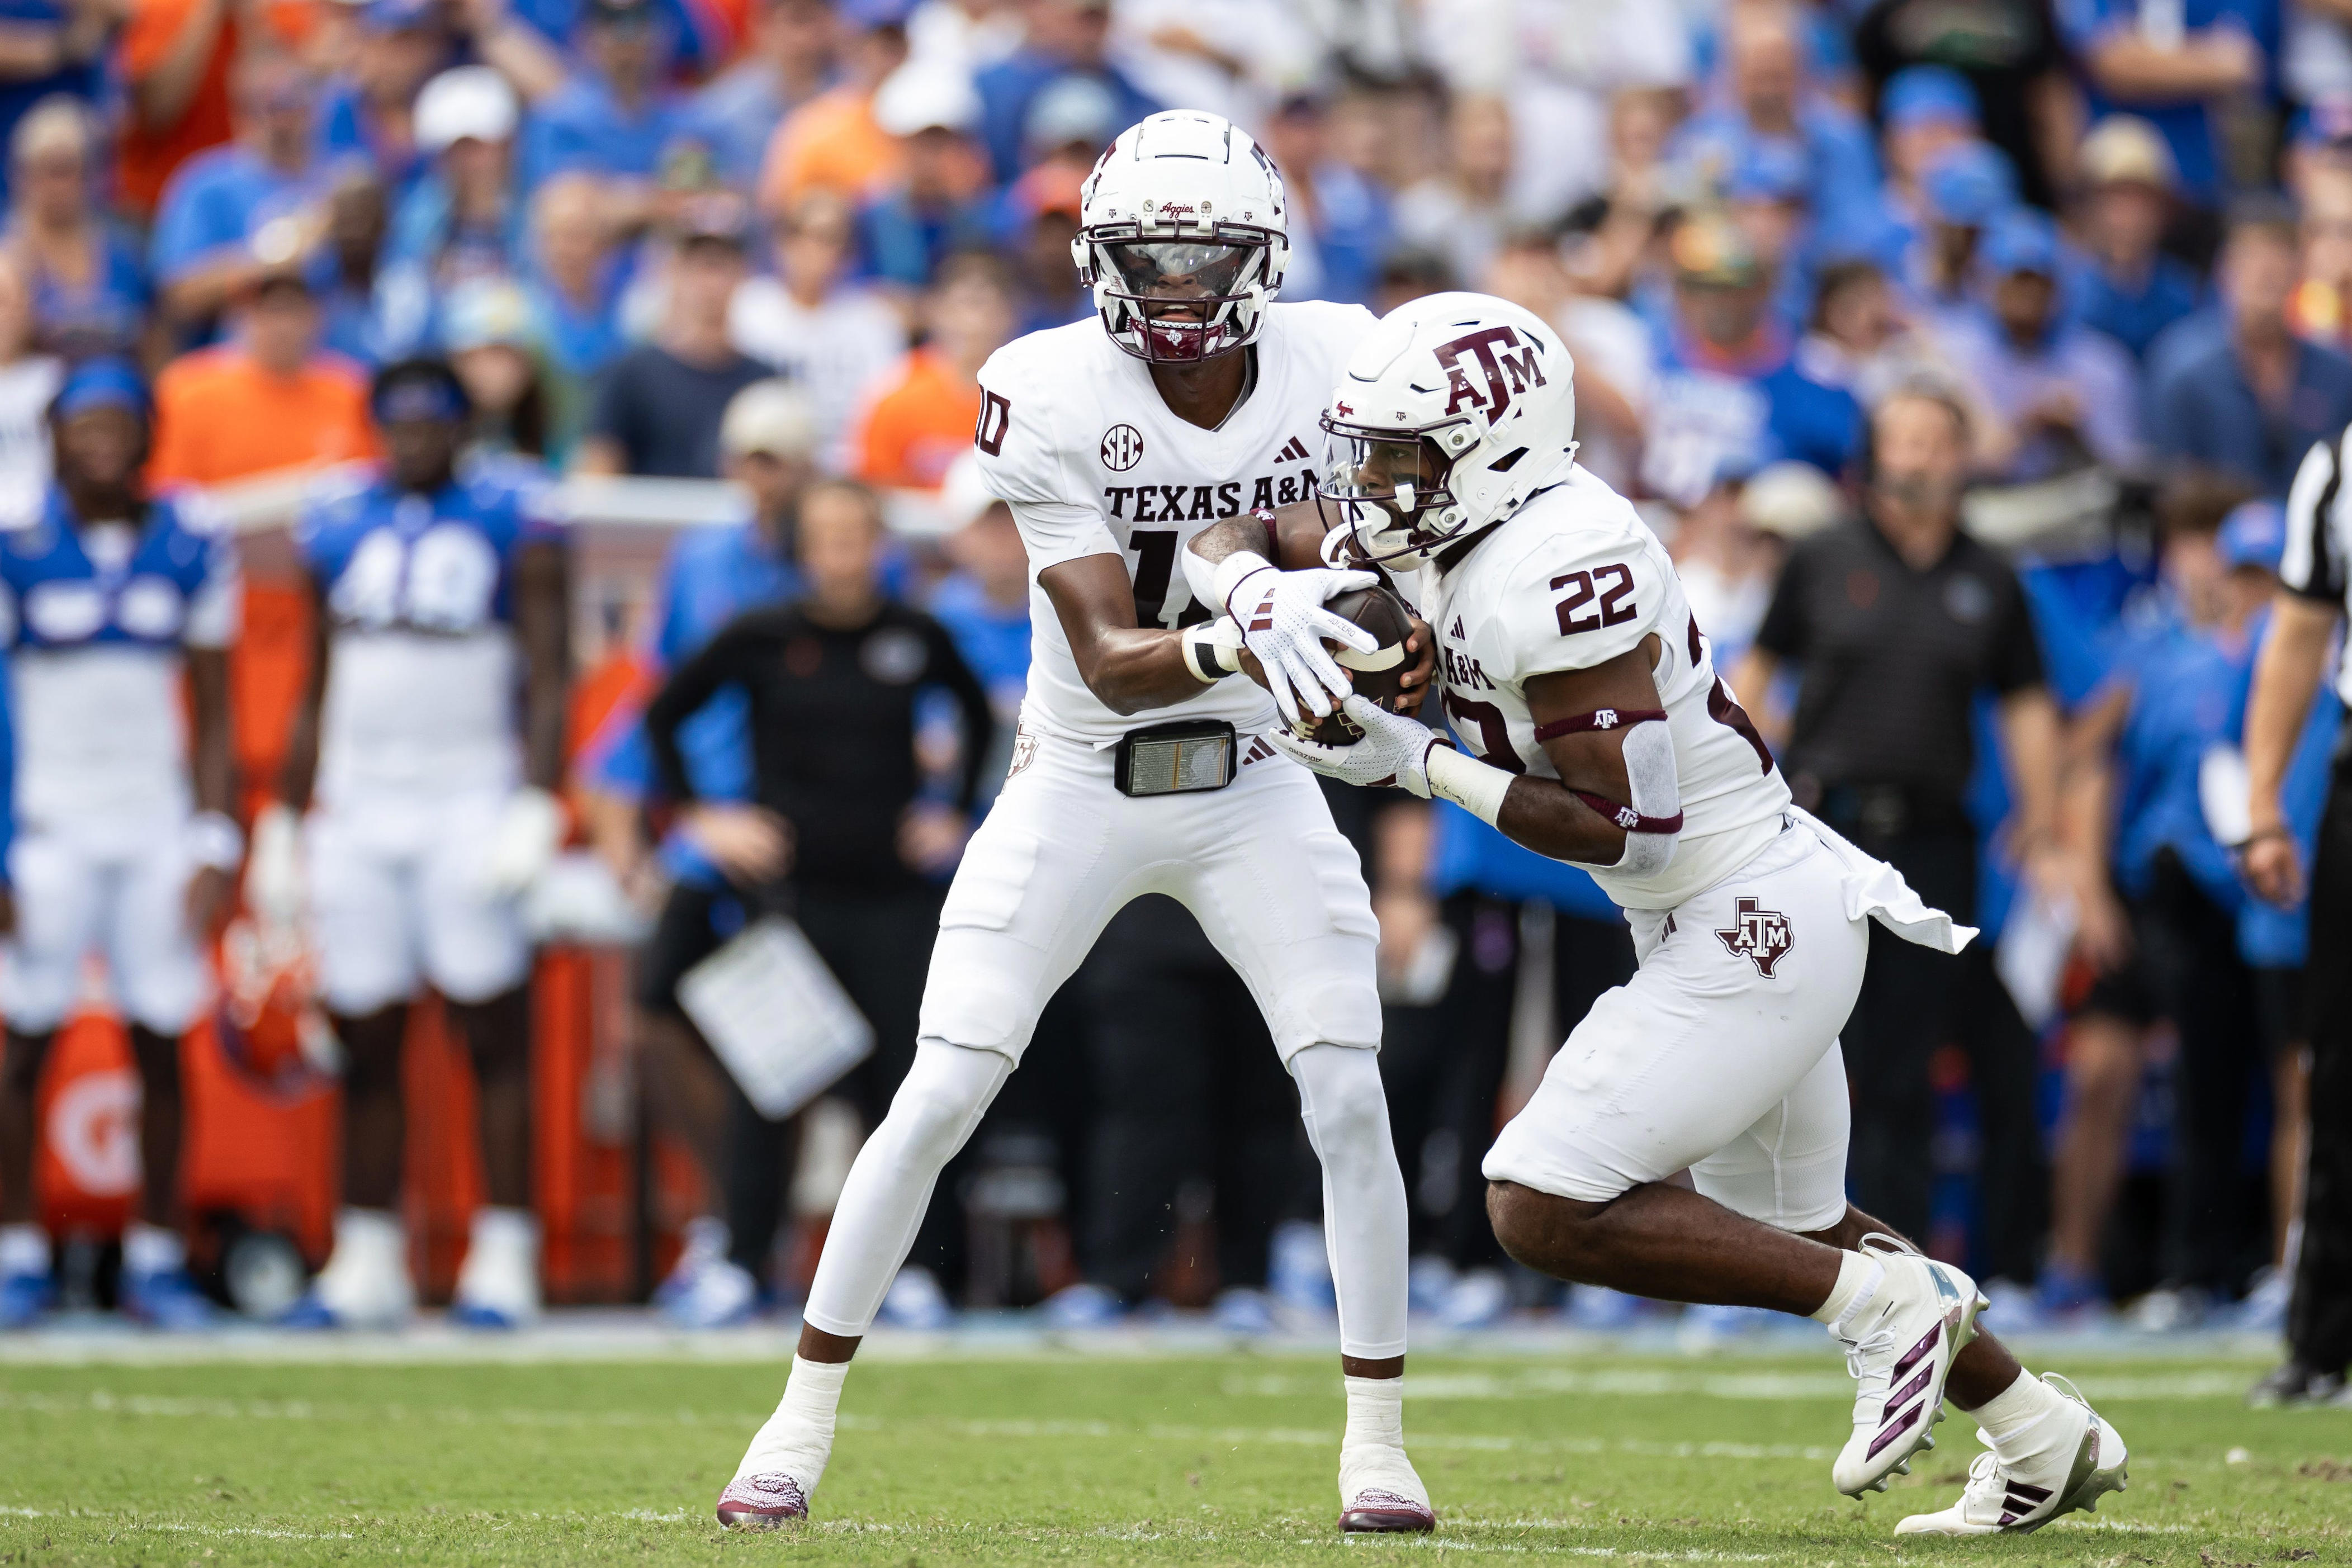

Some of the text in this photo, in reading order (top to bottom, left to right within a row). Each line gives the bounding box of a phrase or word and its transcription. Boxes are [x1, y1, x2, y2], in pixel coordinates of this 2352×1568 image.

[1160, 202, 1195, 219] Aggies
[1102, 425, 1142, 470] SEC
[1104, 481, 1241, 523] TEXAS
[1549, 563, 1637, 637] 22
[1444, 645, 1497, 691] A&M
[1288, 746, 1323, 763] ADIZERO
[1734, 912, 1787, 958] ATM
